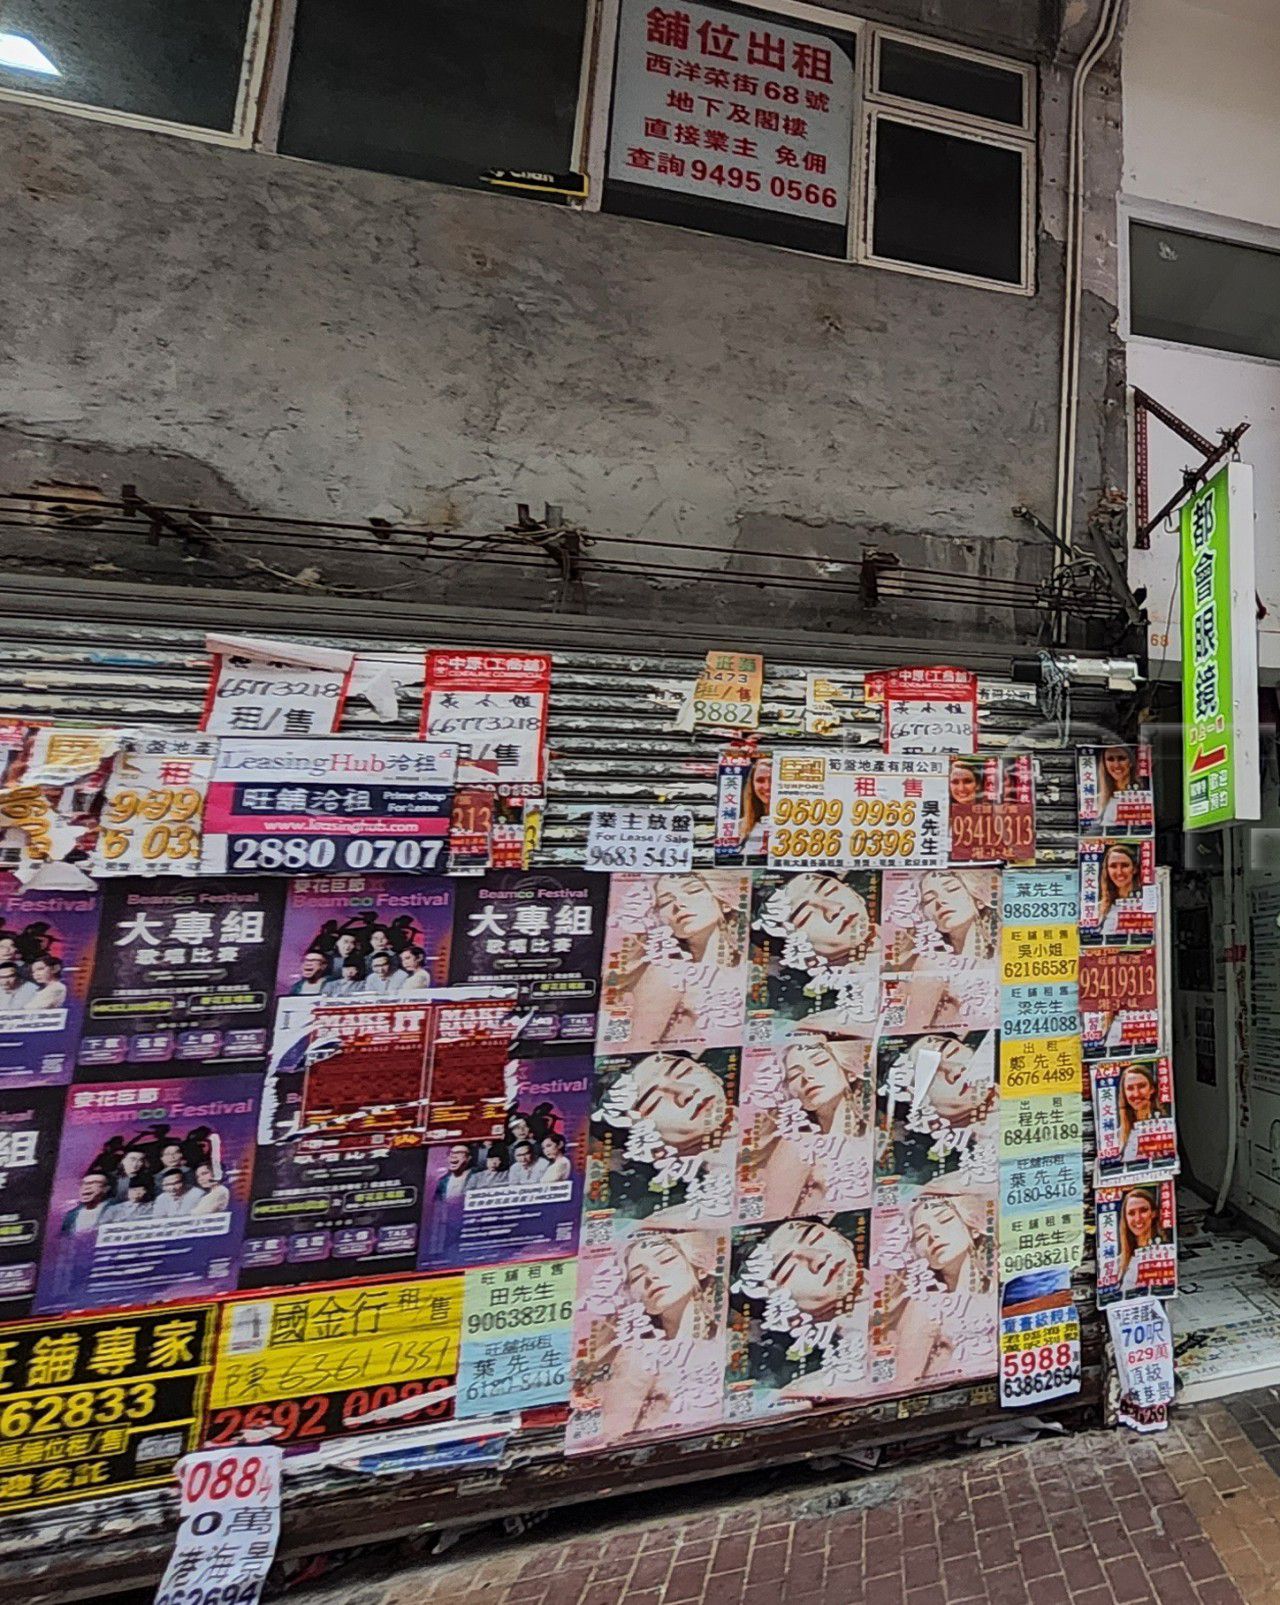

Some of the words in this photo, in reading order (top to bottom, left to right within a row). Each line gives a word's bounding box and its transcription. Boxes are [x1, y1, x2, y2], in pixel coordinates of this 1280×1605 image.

[646, 7, 834, 85] 舖位出租
[645, 52, 830, 113] 西洋菜街68號
[666, 90, 808, 141] 地下及閣樓
[644, 117, 757, 158] 直接業主
[775, 145, 827, 175] 免佣
[770, 178, 837, 208] 0566
[1150, 632, 1169, 647] 68
[222, 750, 385, 776] LeasingHub
[828, 758, 943, 774] 筍盤地產有限公司
[774, 799, 843, 826] 9609
[851, 800, 917, 827] 9966
[596, 832, 616, 842] For
[620, 833, 653, 843] Lease
[664, 834, 689, 844] Sale
[772, 829, 843, 857] 3686
[850, 829, 916, 857] 0396
[954, 816, 1034, 846] 93419313
[232, 838, 336, 869] 2880
[345, 839, 444, 869] 0707
[590, 846, 637, 866] 9683
[376, 892, 449, 907] Festival
[537, 888, 589, 899] Festival
[1016, 882, 1064, 898] 葉先生
[1084, 863, 1098, 919] 英文補習
[466, 904, 594, 937] 大專組
[1003, 902, 1078, 919] 98628373
[113, 910, 266, 947] 大專組
[1004, 960, 1078, 979] 62166587
[1080, 965, 1155, 999] 93419313
[1003, 1015, 1078, 1036] 94244088
[1006, 1071, 1040, 1088] 6676
[1042, 1067, 1075, 1085] 4489
[170, 1099, 254, 1118] Festival
[1018, 1109, 1065, 1127] 程先生
[1101, 1088, 1115, 1147] 英文補習
[1018, 1229, 1067, 1250] 田先生
[1103, 1213, 1116, 1275] 英文補習
[1004, 1245, 1080, 1274] 90638216
[489, 1282, 556, 1307] 田先生
[467, 1300, 573, 1335] 90638216
[1003, 1343, 1072, 1377] 5988
